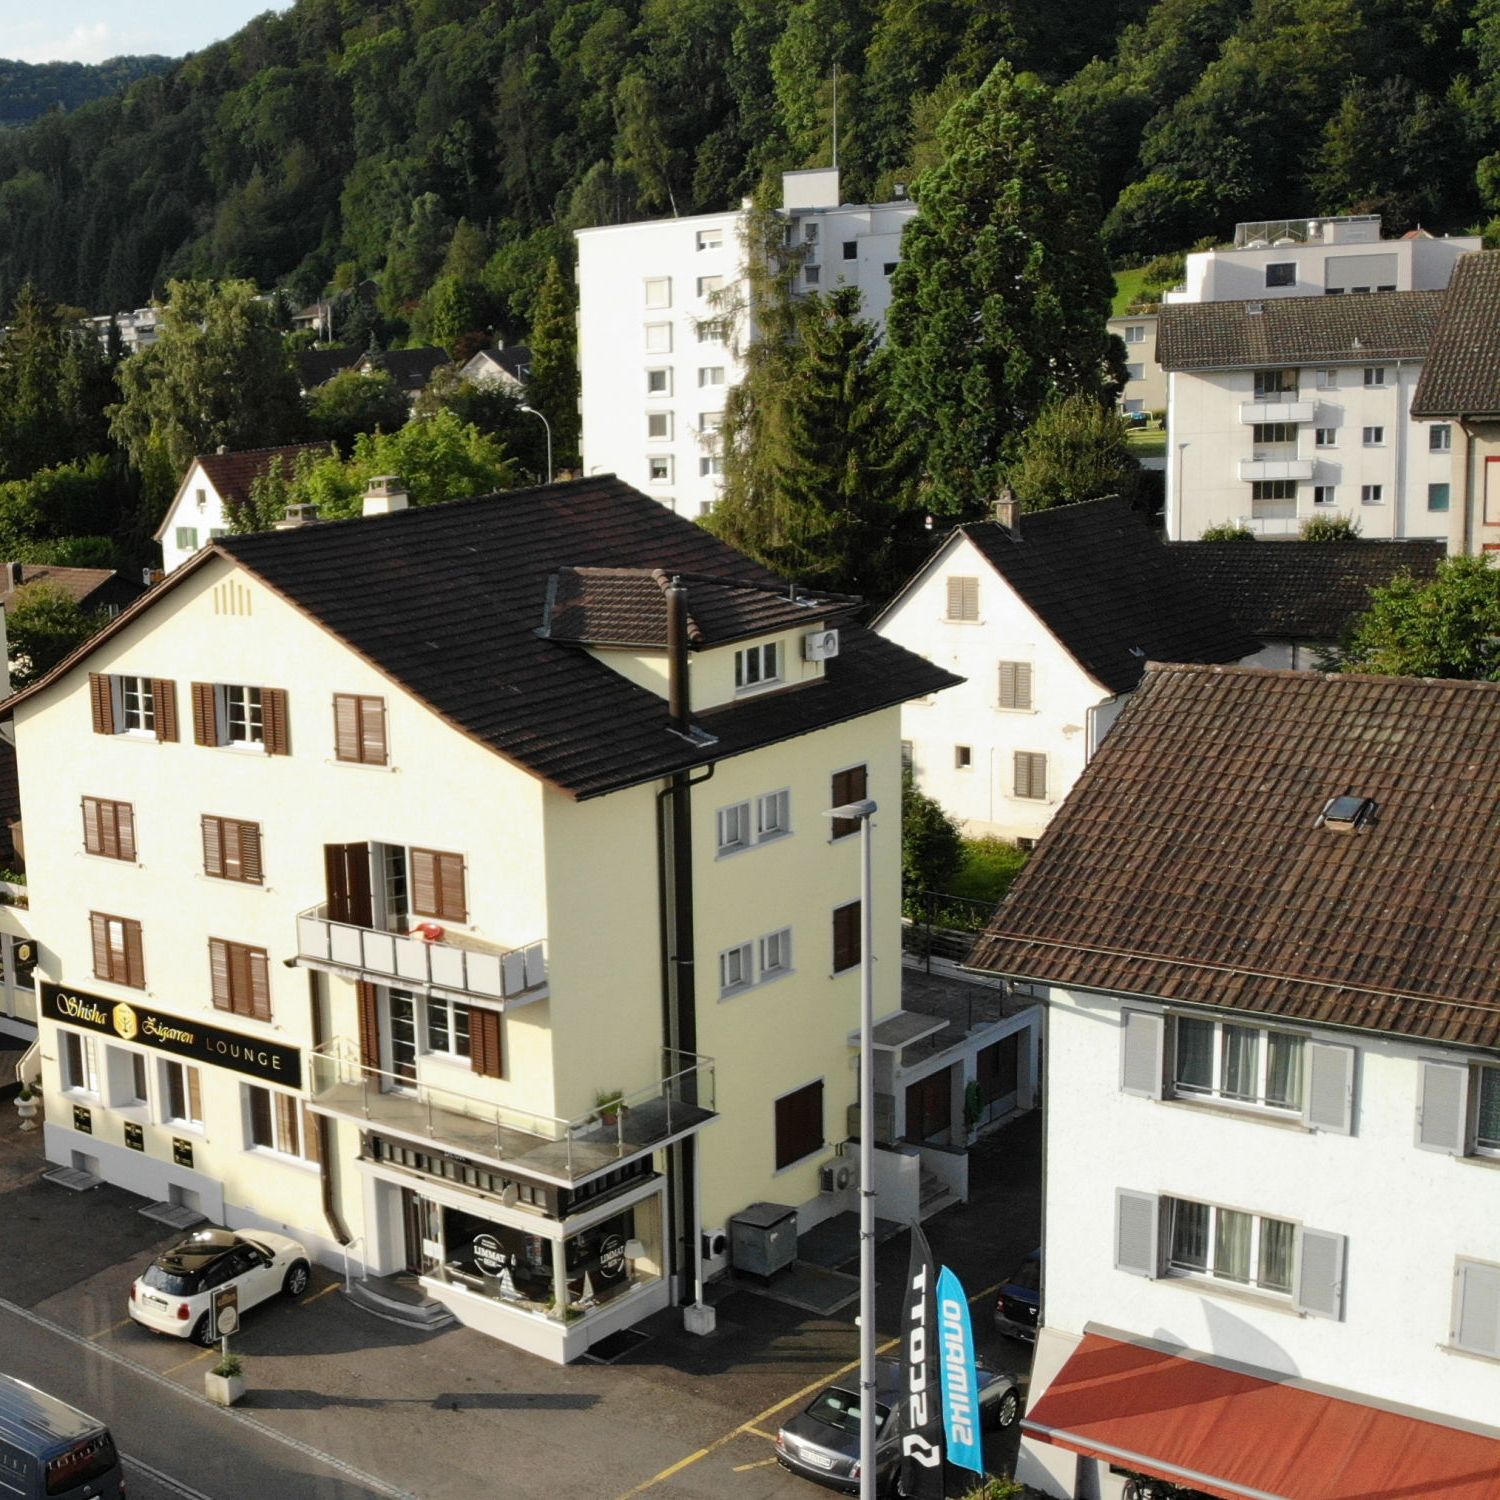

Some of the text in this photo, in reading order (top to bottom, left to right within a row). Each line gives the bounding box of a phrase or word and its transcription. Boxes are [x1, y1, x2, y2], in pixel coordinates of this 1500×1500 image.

[56, 993, 282, 1070] Shisha Zigarren LOUNGE
[473, 1244, 506, 1264] LIMMAT
